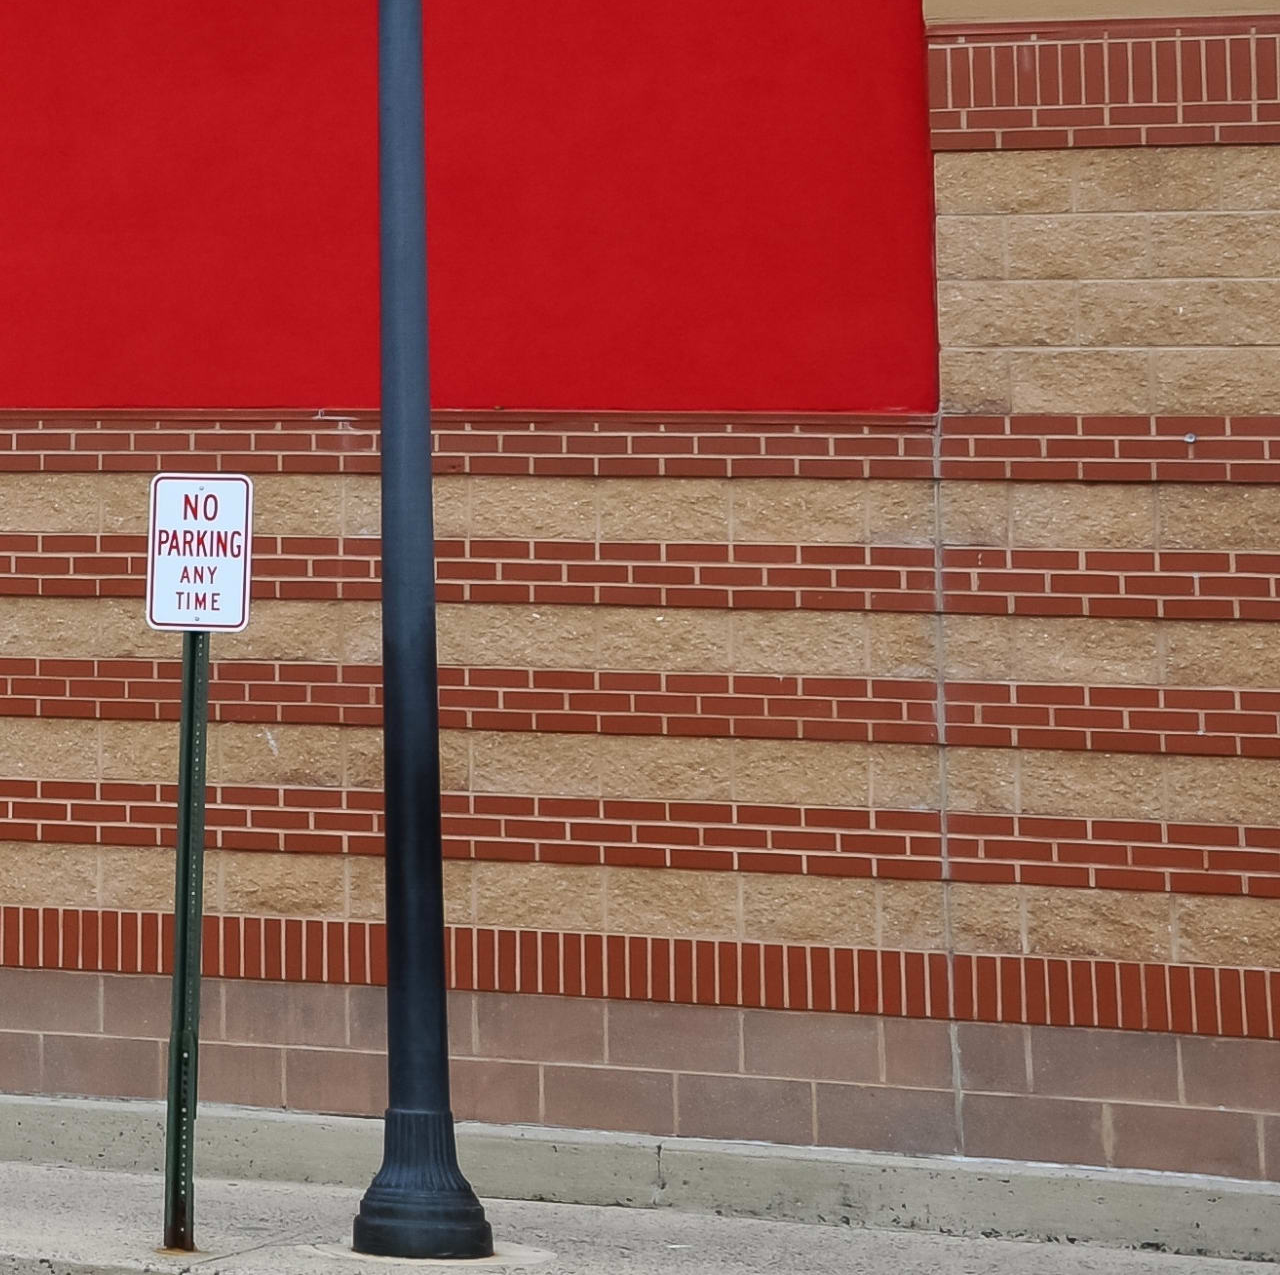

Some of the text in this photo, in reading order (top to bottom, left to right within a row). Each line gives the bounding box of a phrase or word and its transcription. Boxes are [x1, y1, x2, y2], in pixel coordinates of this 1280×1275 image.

[183, 493, 219, 521] NO
[157, 529, 242, 558] PARKING
[179, 566, 218, 584] ANY
[175, 591, 221, 611] TIME
